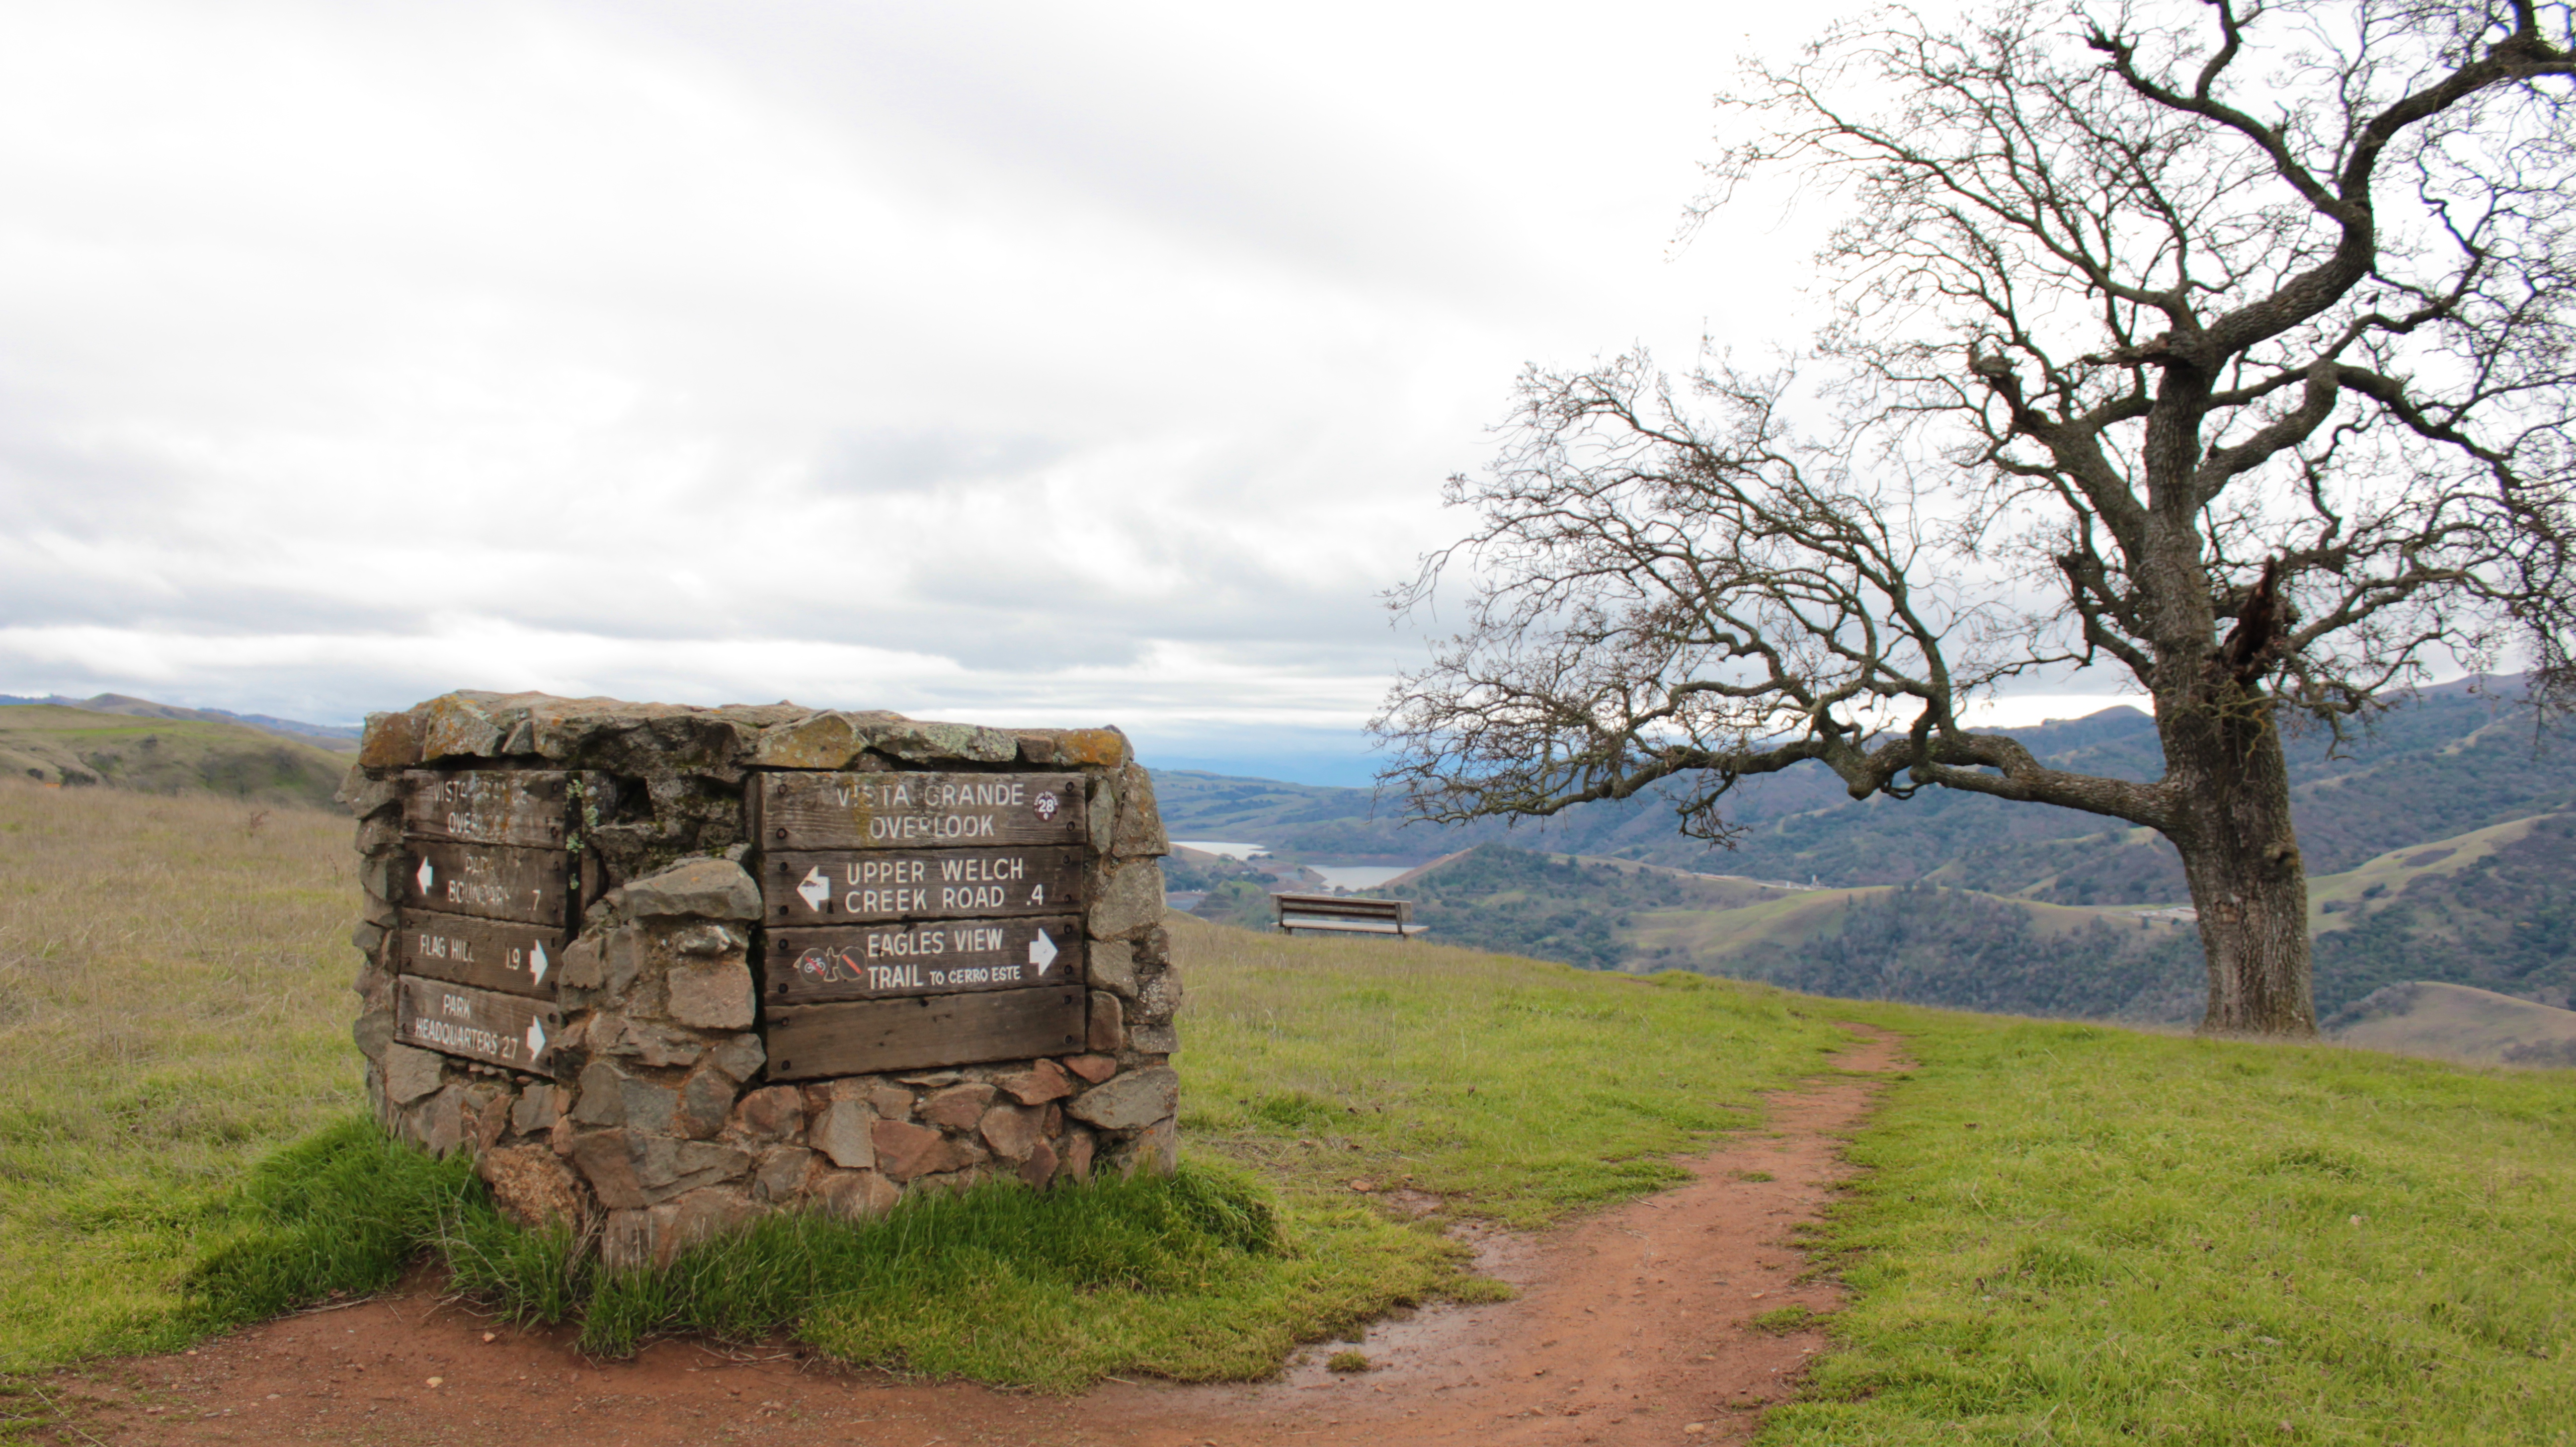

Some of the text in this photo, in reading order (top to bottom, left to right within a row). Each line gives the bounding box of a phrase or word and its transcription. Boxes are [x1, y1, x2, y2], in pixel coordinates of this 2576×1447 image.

[837, 783, 1024, 806] VISTA GRANDE
[1038, 799, 1054, 812] 28
[870, 814, 994, 839] OVERLOOK
[847, 858, 1024, 885] UPPER WELCH
[845, 884, 1044, 913] CREEK ROAD .4
[420, 934, 521, 970] FLAG HILL 1.9
[868, 928, 1003, 958] EAGLES VIEW
[868, 964, 1021, 989] TRAIL TO CERRO ESTE
[443, 994, 471, 1019] PARK
[414, 1017, 498, 1055] HEADQUARTERS
